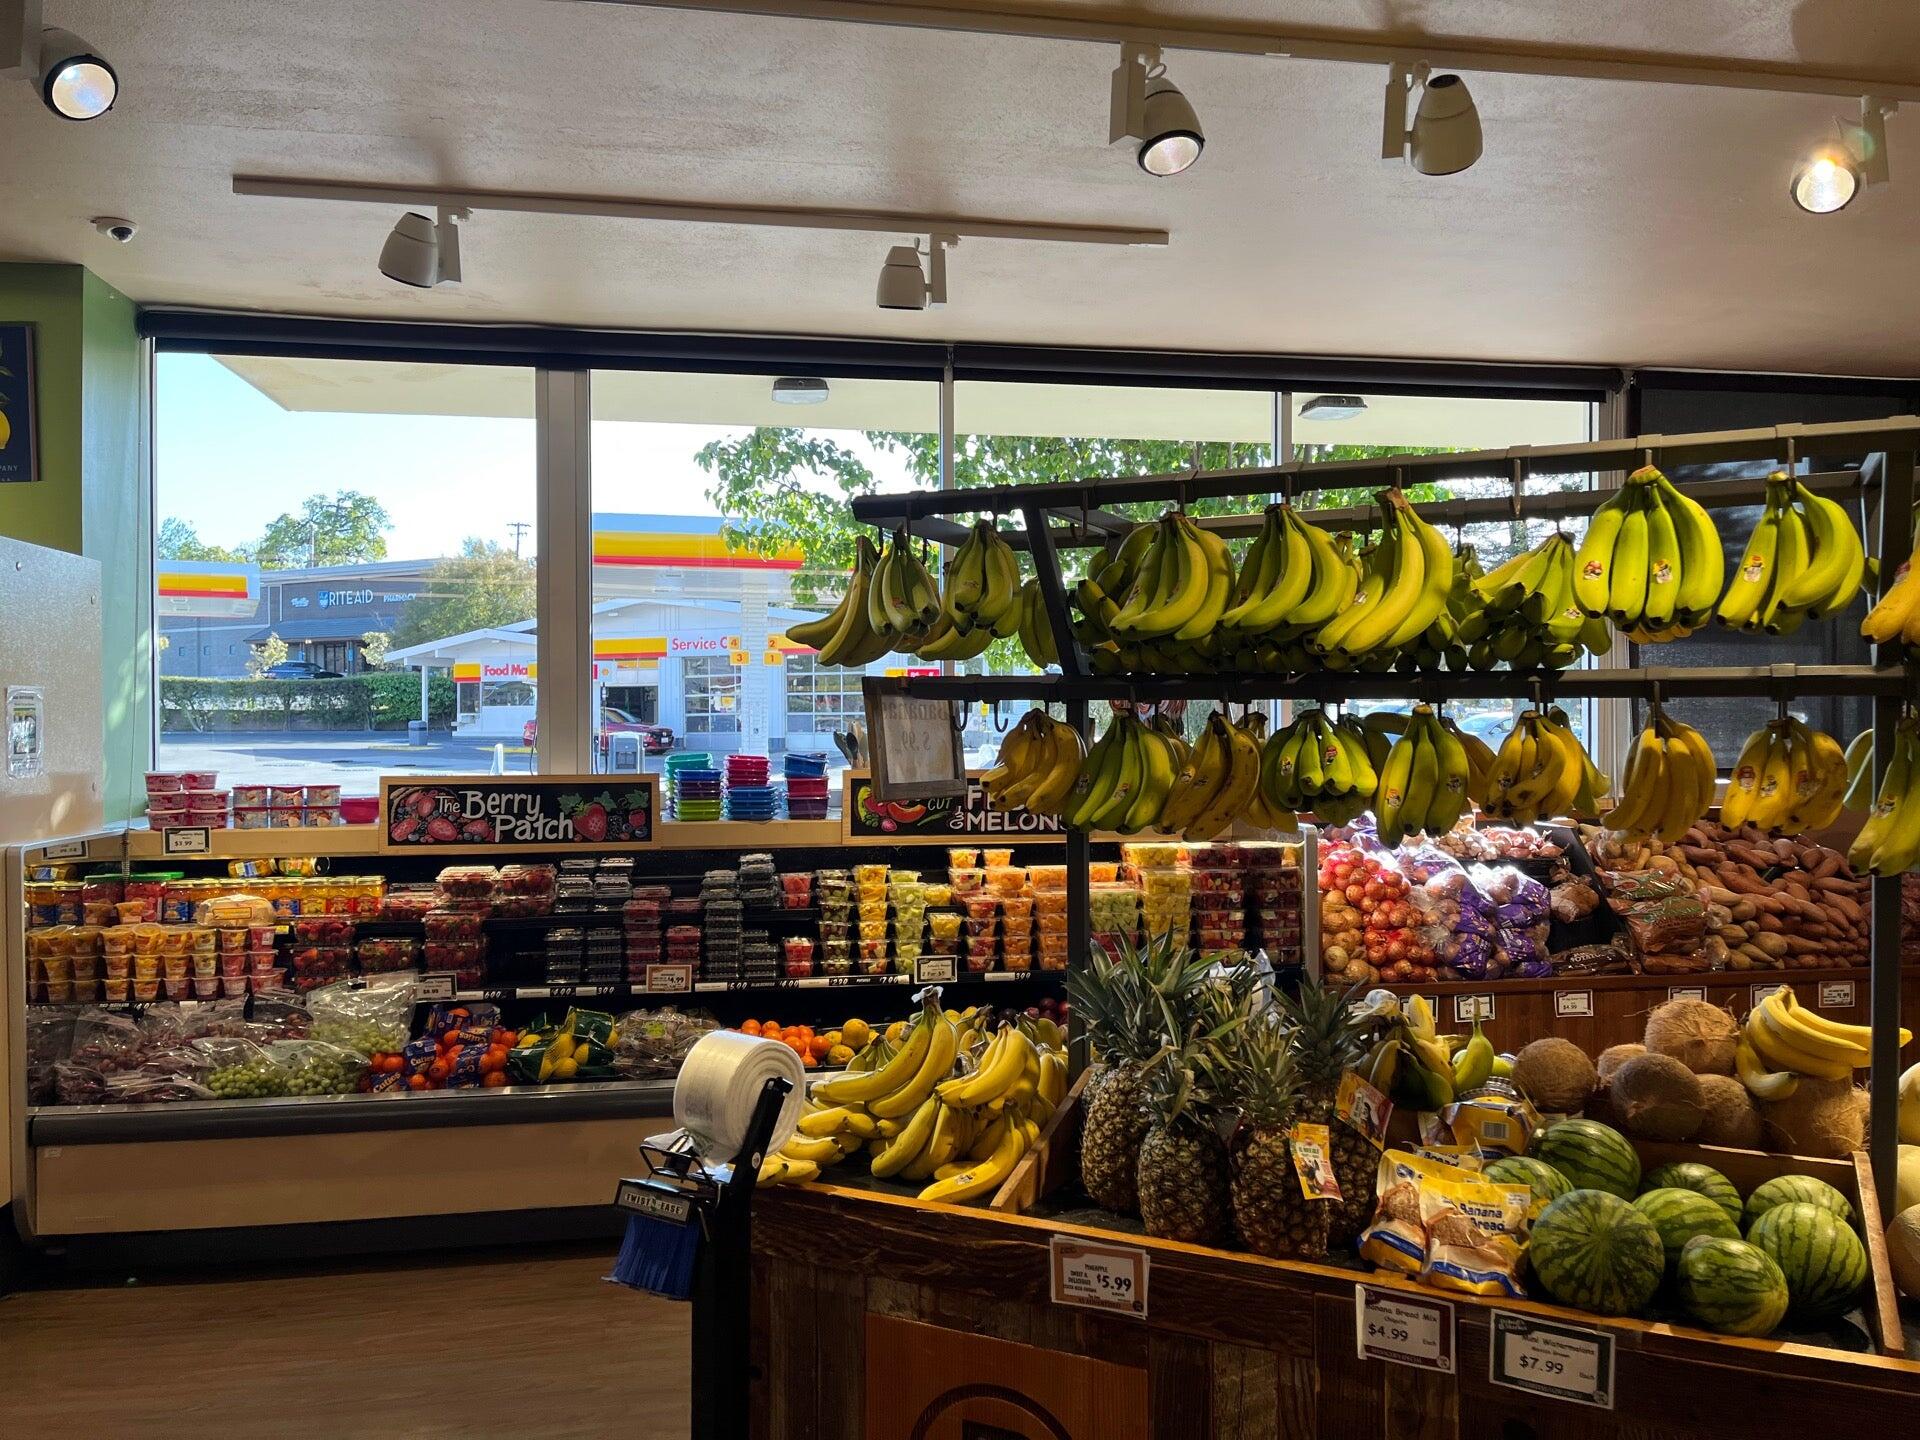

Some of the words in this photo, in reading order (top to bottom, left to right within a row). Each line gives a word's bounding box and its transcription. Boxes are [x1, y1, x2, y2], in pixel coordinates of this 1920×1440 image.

[383, 592, 417, 603] PHARMACY
[672, 636, 717, 651] Service
[736, 653, 743, 662] 3
[484, 663, 509, 676] Food
[511, 664, 528, 676] Ma
[435, 795, 461, 814] The
[458, 790, 541, 821] Berry
[927, 797, 953, 811] CUT
[491, 811, 574, 842] Patch
[625, 1193, 650, 1207] TWIST
[661, 1202, 682, 1214] EASE
[1460, 1203, 1503, 1218] Banana
[1084, 1263, 1108, 1273] PINEAPPLE
[1097, 1274, 1132, 1292] $5.99
[1396, 1308, 1420, 1319] Bread
[1423, 1313, 1438, 1322] Mix
[1368, 1322, 1409, 1342] $4.99
[1519, 1353, 1564, 1374] $7.99
